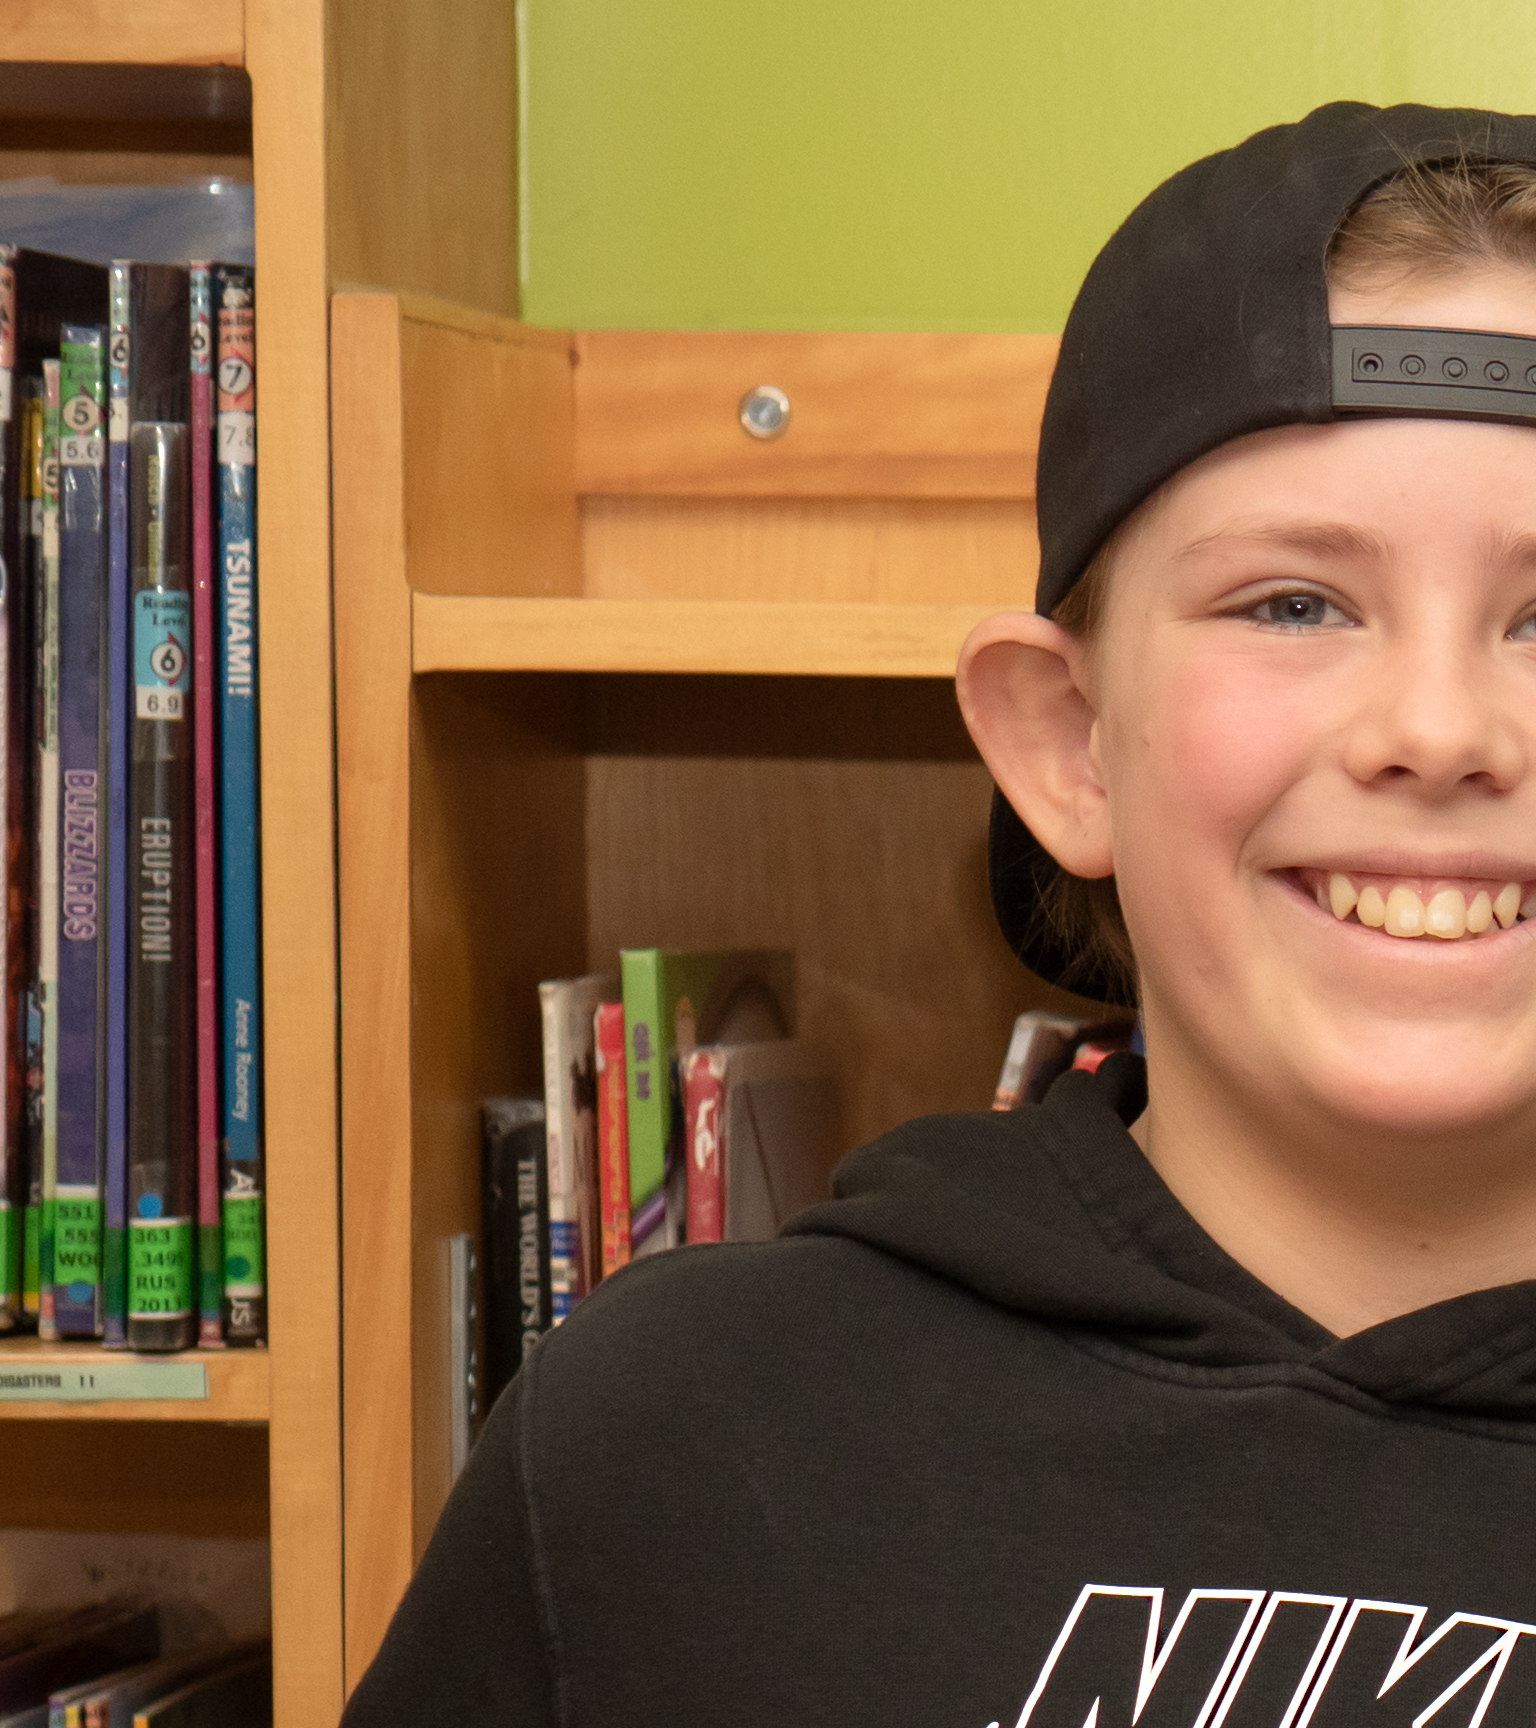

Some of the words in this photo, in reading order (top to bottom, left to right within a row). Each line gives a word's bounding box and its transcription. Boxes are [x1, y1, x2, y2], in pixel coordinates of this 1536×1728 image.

[225, 364, 244, 390] 7
[72, 401, 90, 426] 5
[225, 538, 253, 696] TSUNAMI!
[159, 649, 176, 674] 6
[146, 694, 180, 715] 6.9
[63, 769, 98, 941] BLIZZARDS
[140, 816, 172, 963] ERUPTION!
[234, 998, 253, 1048] Anne
[231, 1051, 253, 1122] Rooney
[517, 1156, 540, 1208] THE
